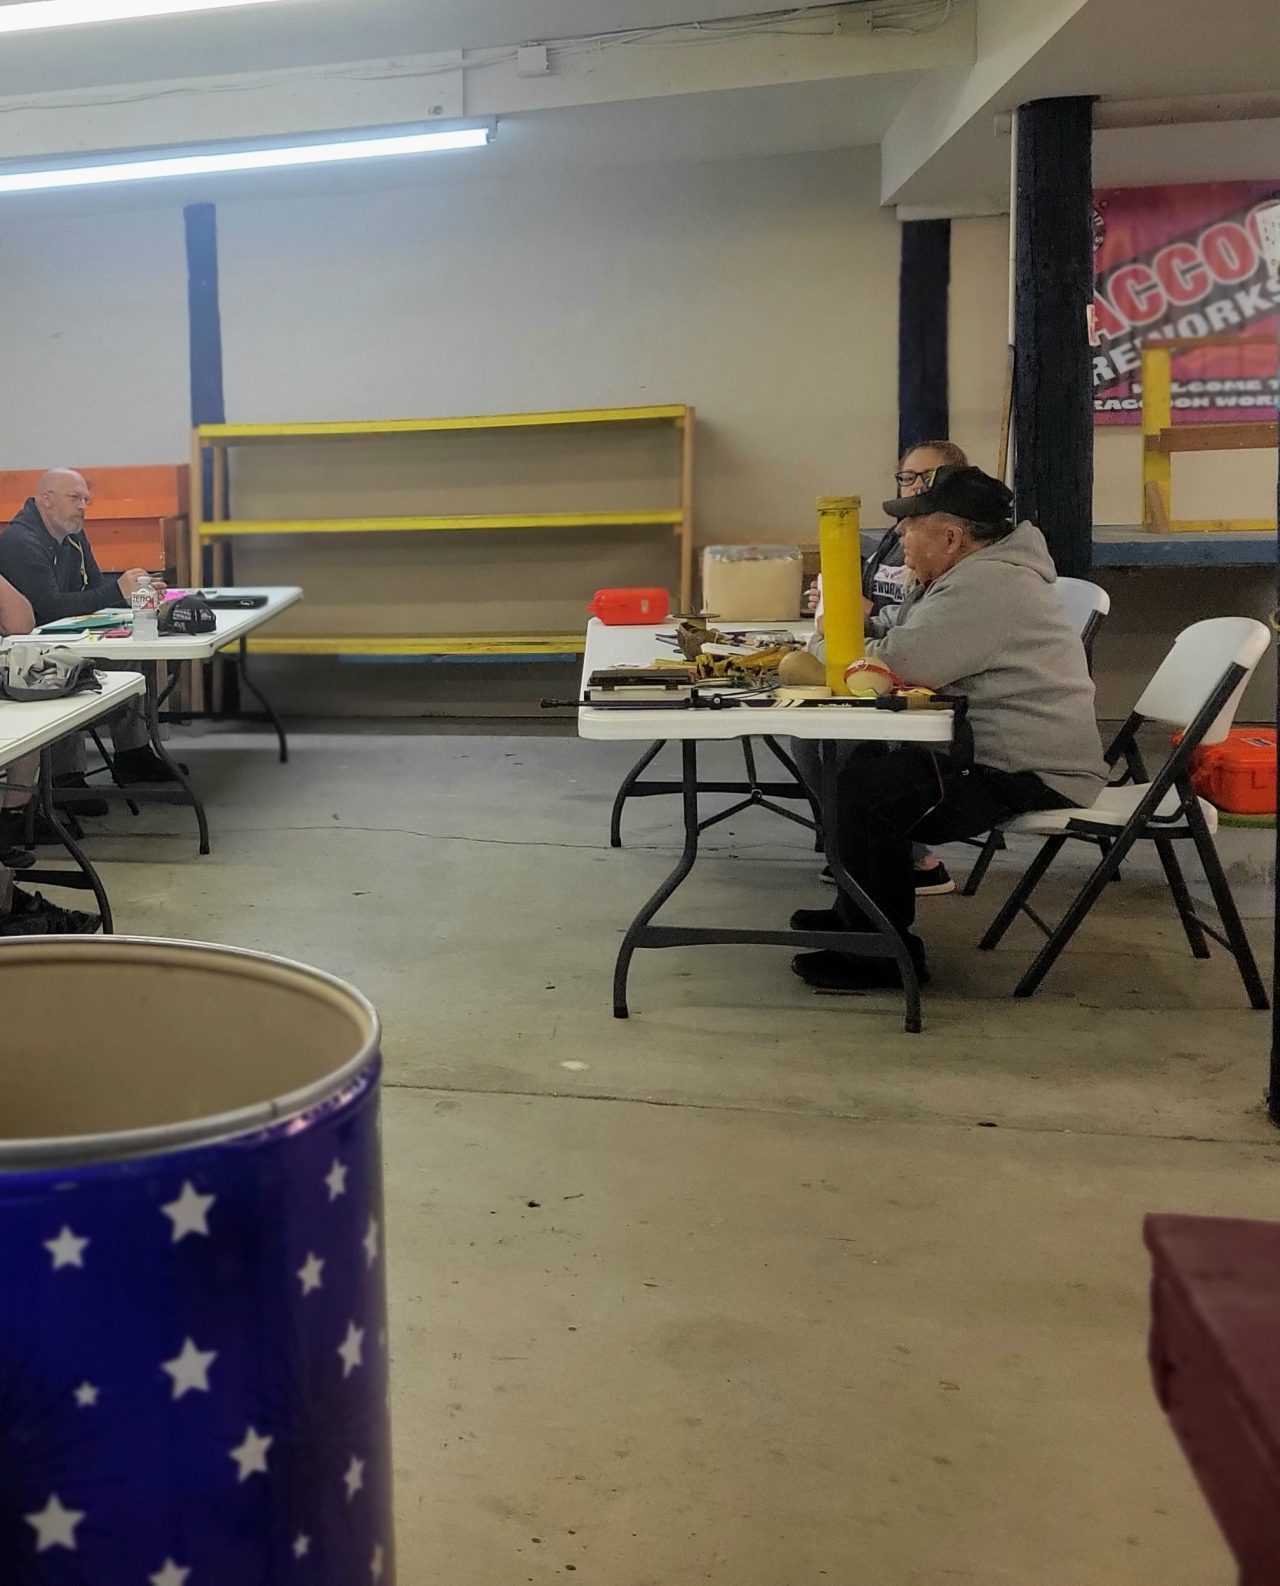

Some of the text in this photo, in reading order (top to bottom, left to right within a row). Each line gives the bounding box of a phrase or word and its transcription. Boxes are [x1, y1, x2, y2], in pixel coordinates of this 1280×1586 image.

[1088, 199, 1280, 346] ACCO
[1132, 380, 1262, 395] LCOME
[1215, 394, 1278, 407] WOR
